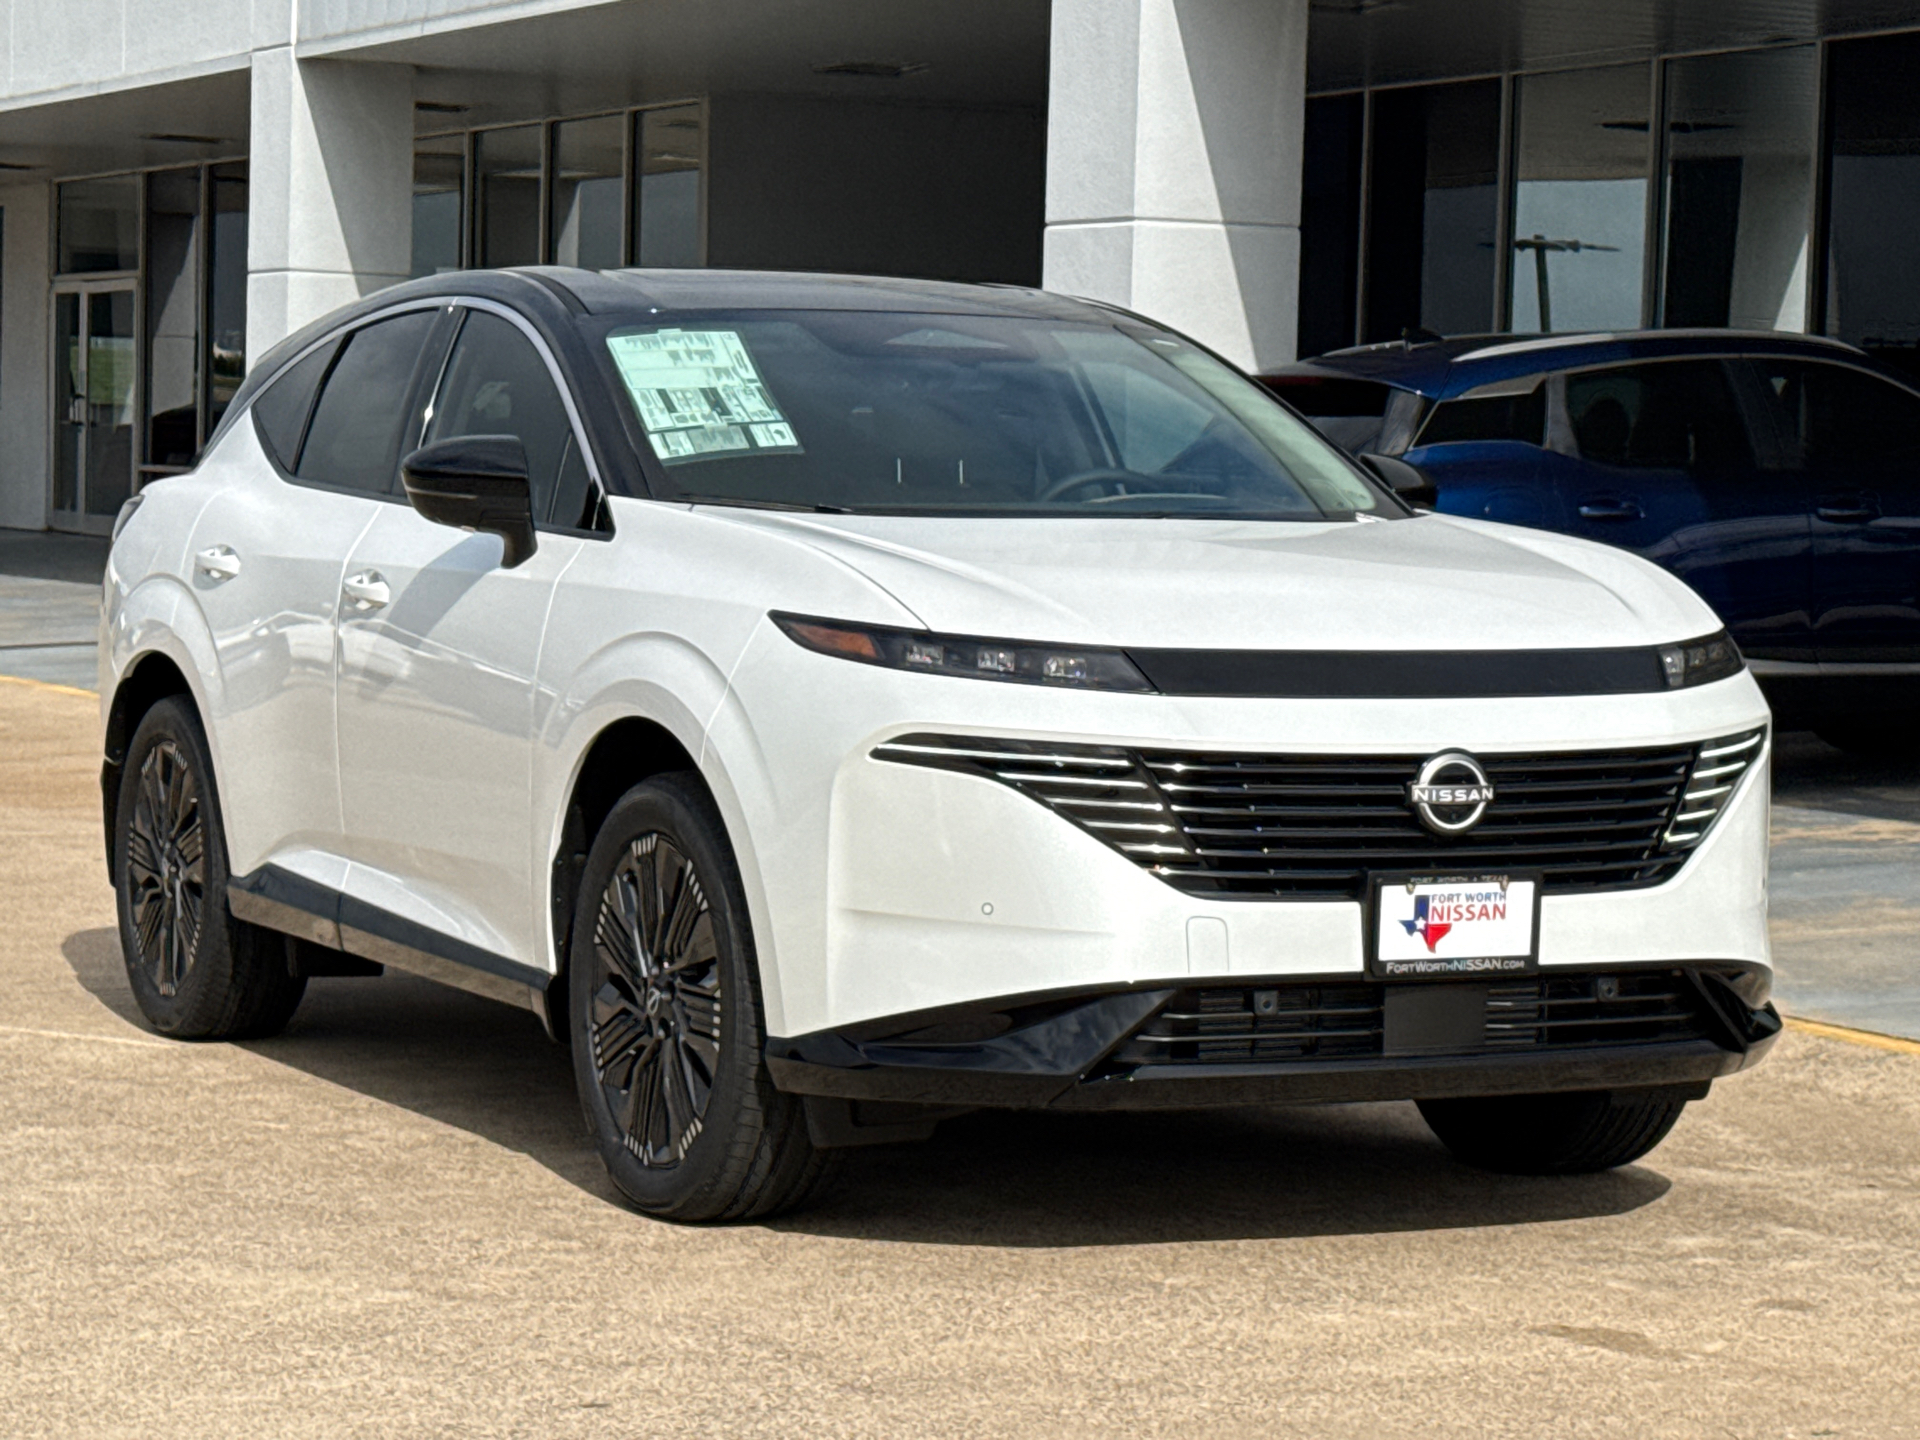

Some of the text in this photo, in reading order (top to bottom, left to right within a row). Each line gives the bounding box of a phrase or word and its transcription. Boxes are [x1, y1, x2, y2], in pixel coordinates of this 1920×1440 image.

[1413, 787, 1494, 802] NISSAN
[1431, 891, 1507, 904] FORT WORTH
[1430, 903, 1507, 922] NISSAN
